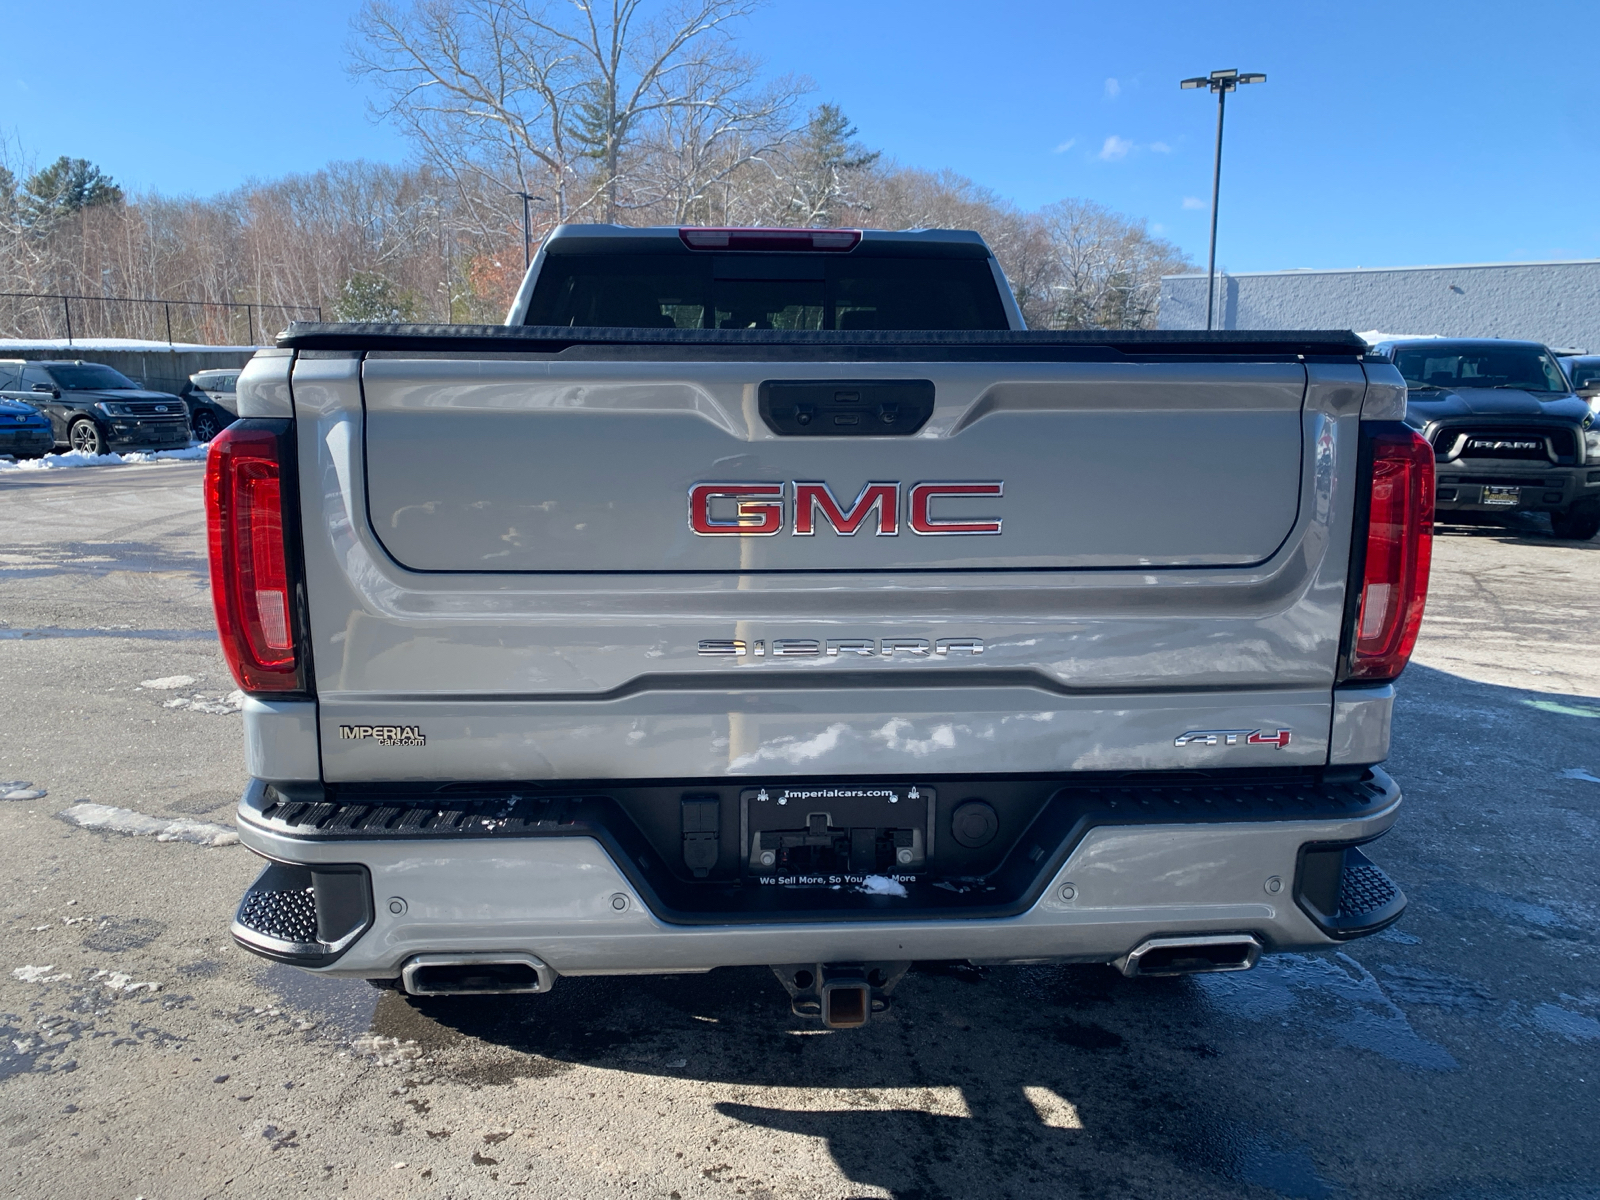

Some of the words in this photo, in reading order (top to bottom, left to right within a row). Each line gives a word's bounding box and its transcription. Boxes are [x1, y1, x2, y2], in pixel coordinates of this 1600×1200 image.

[1474, 441, 1536, 449] RAM
[687, 480, 1004, 537] GMC
[697, 638, 984, 657] SIERRA
[339, 725, 426, 740] IMPERIAL
[1174, 728, 1292, 750] AT4
[378, 738, 426, 746] cars.com
[784, 789, 893, 799] Imperialcars.com
[778, 876, 796, 884] Sell
[799, 876, 826, 885] More,
[829, 875, 842, 883] So
[844, 875, 863, 883] You
[892, 874, 916, 882] More
